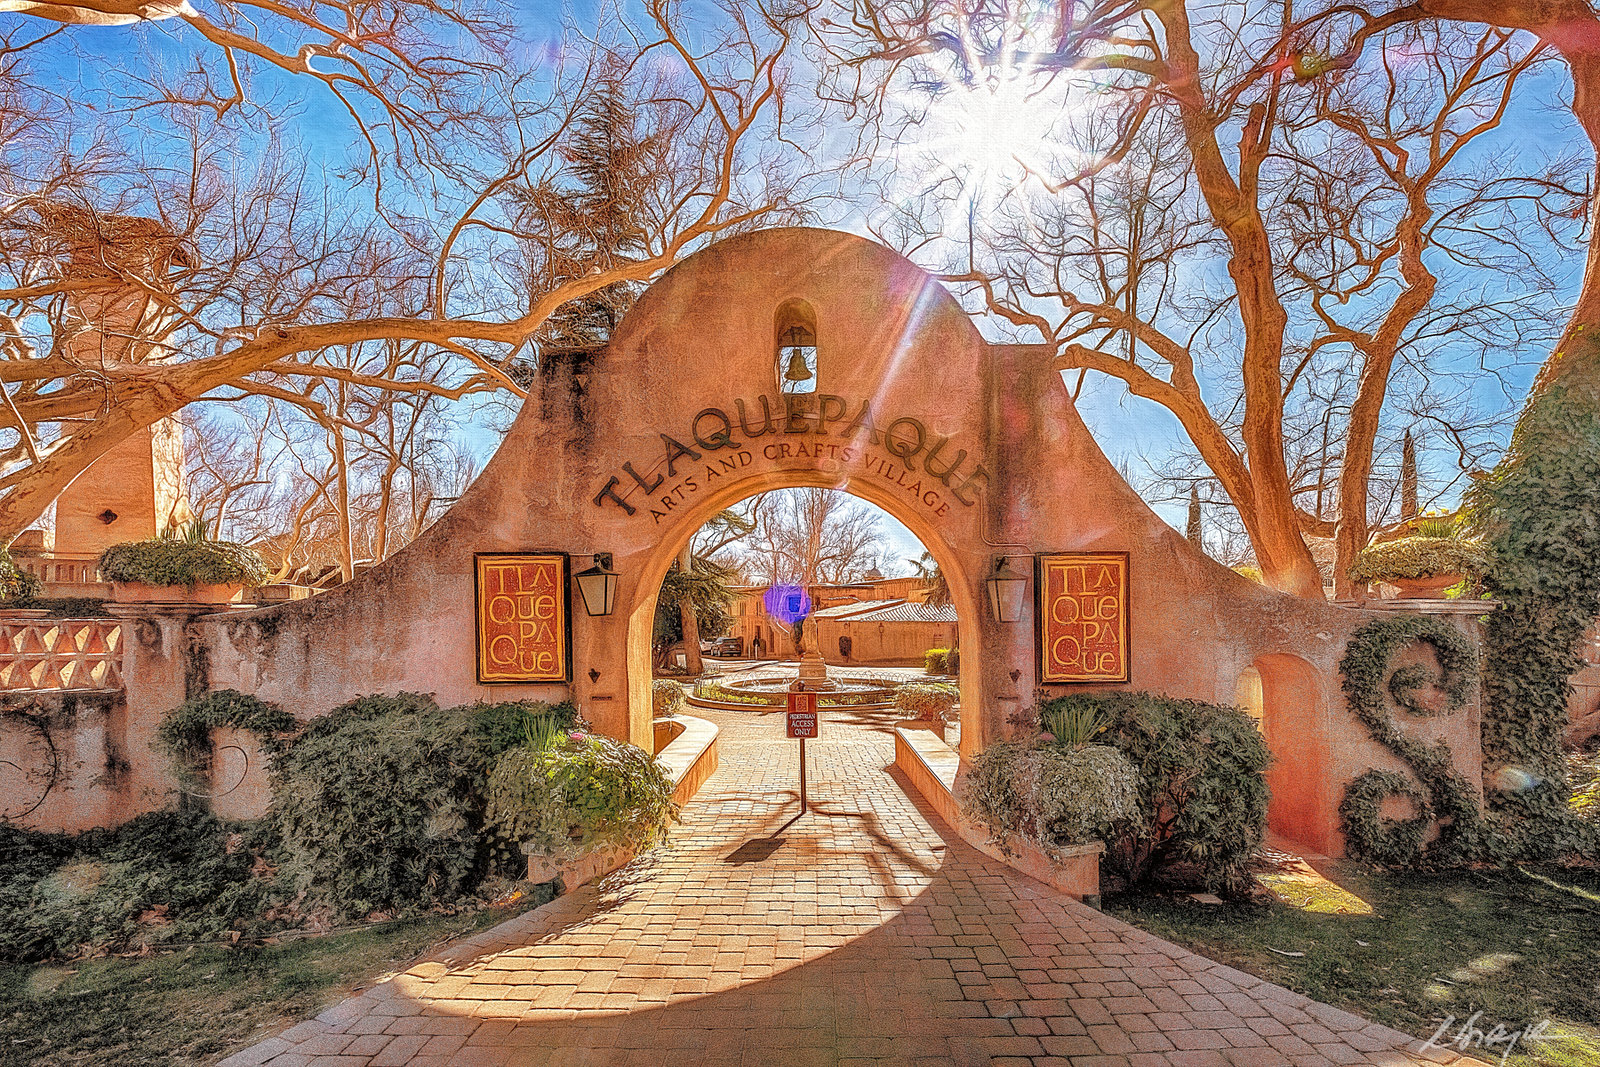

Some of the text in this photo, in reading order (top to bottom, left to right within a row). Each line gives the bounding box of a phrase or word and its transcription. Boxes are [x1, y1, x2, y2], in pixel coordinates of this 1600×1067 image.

[593, 393, 991, 516] TLAQUEPAQUE
[650, 442, 950, 524] ARTS AND CRAFTS VILLAGE
[791, 720, 815, 728] ACCESS
[794, 728, 811, 736] ONLY
